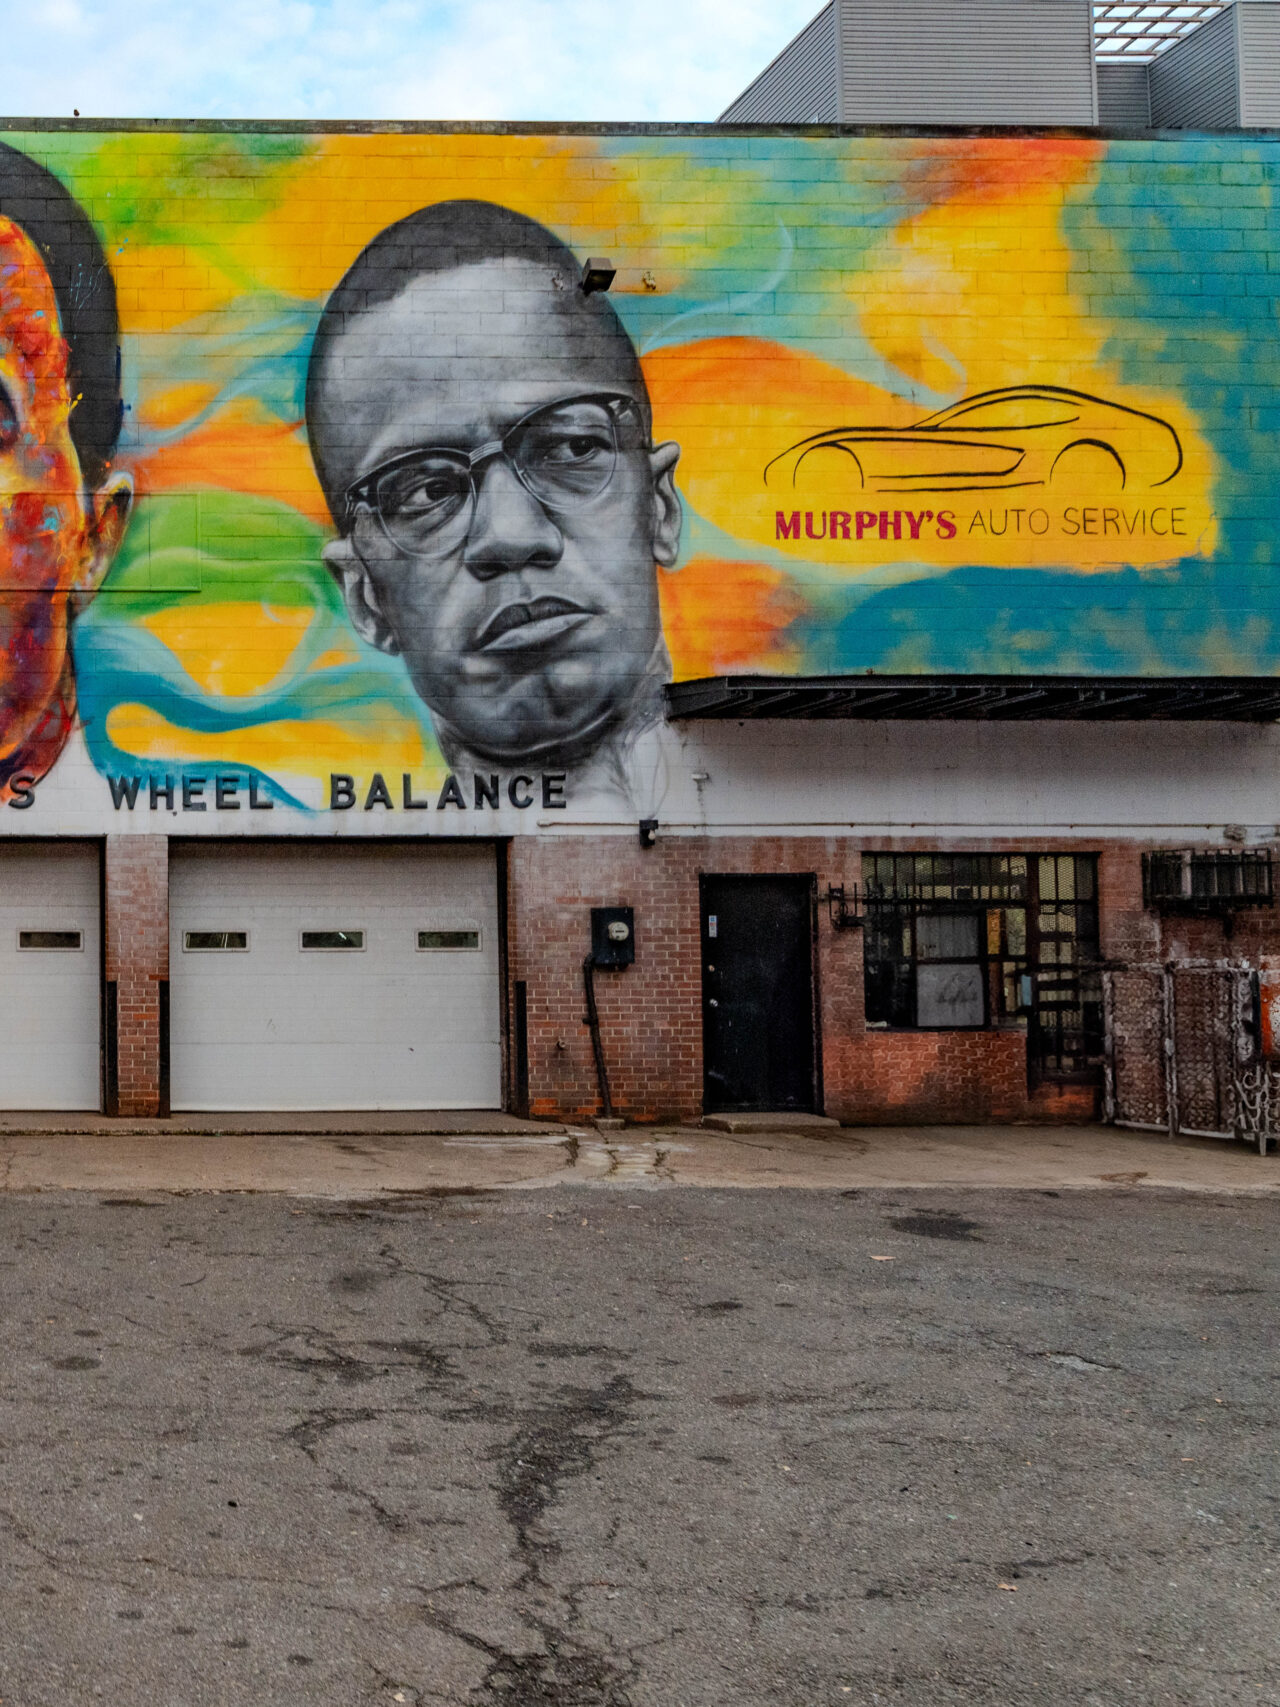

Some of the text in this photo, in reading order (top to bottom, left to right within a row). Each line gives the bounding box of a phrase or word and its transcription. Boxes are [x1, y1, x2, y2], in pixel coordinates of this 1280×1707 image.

[775, 507, 1187, 540] MURPHY'S AUTO SERVICE
[106, 773, 567, 811] WHEEL BALANCE
